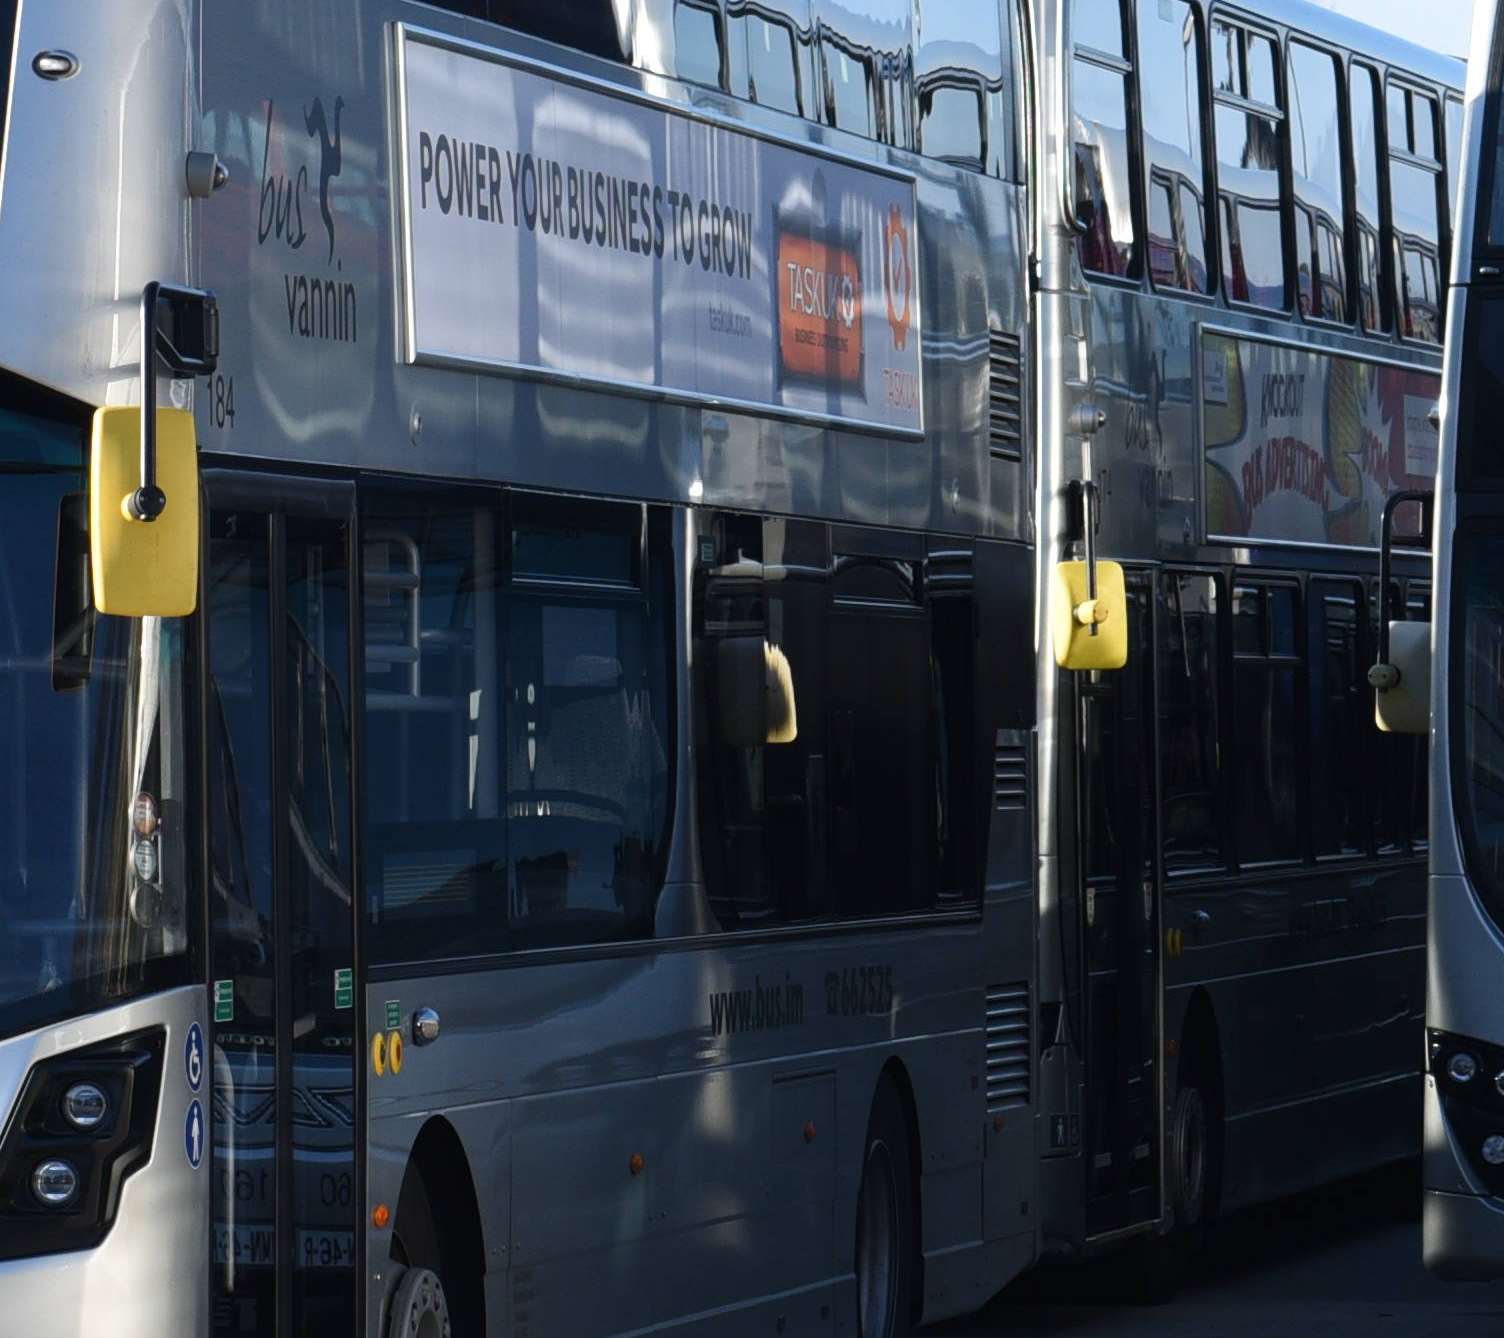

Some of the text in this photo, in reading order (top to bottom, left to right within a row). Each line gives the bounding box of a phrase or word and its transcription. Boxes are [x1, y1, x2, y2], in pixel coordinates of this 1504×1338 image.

[257, 98, 308, 249] bus
[419, 131, 752, 280] POWER YOUR BUSINESS TO GROW
[284, 258, 357, 343] vannin
[206, 375, 235, 429] 184
[709, 964, 893, 1036] www.bus.im 662525
